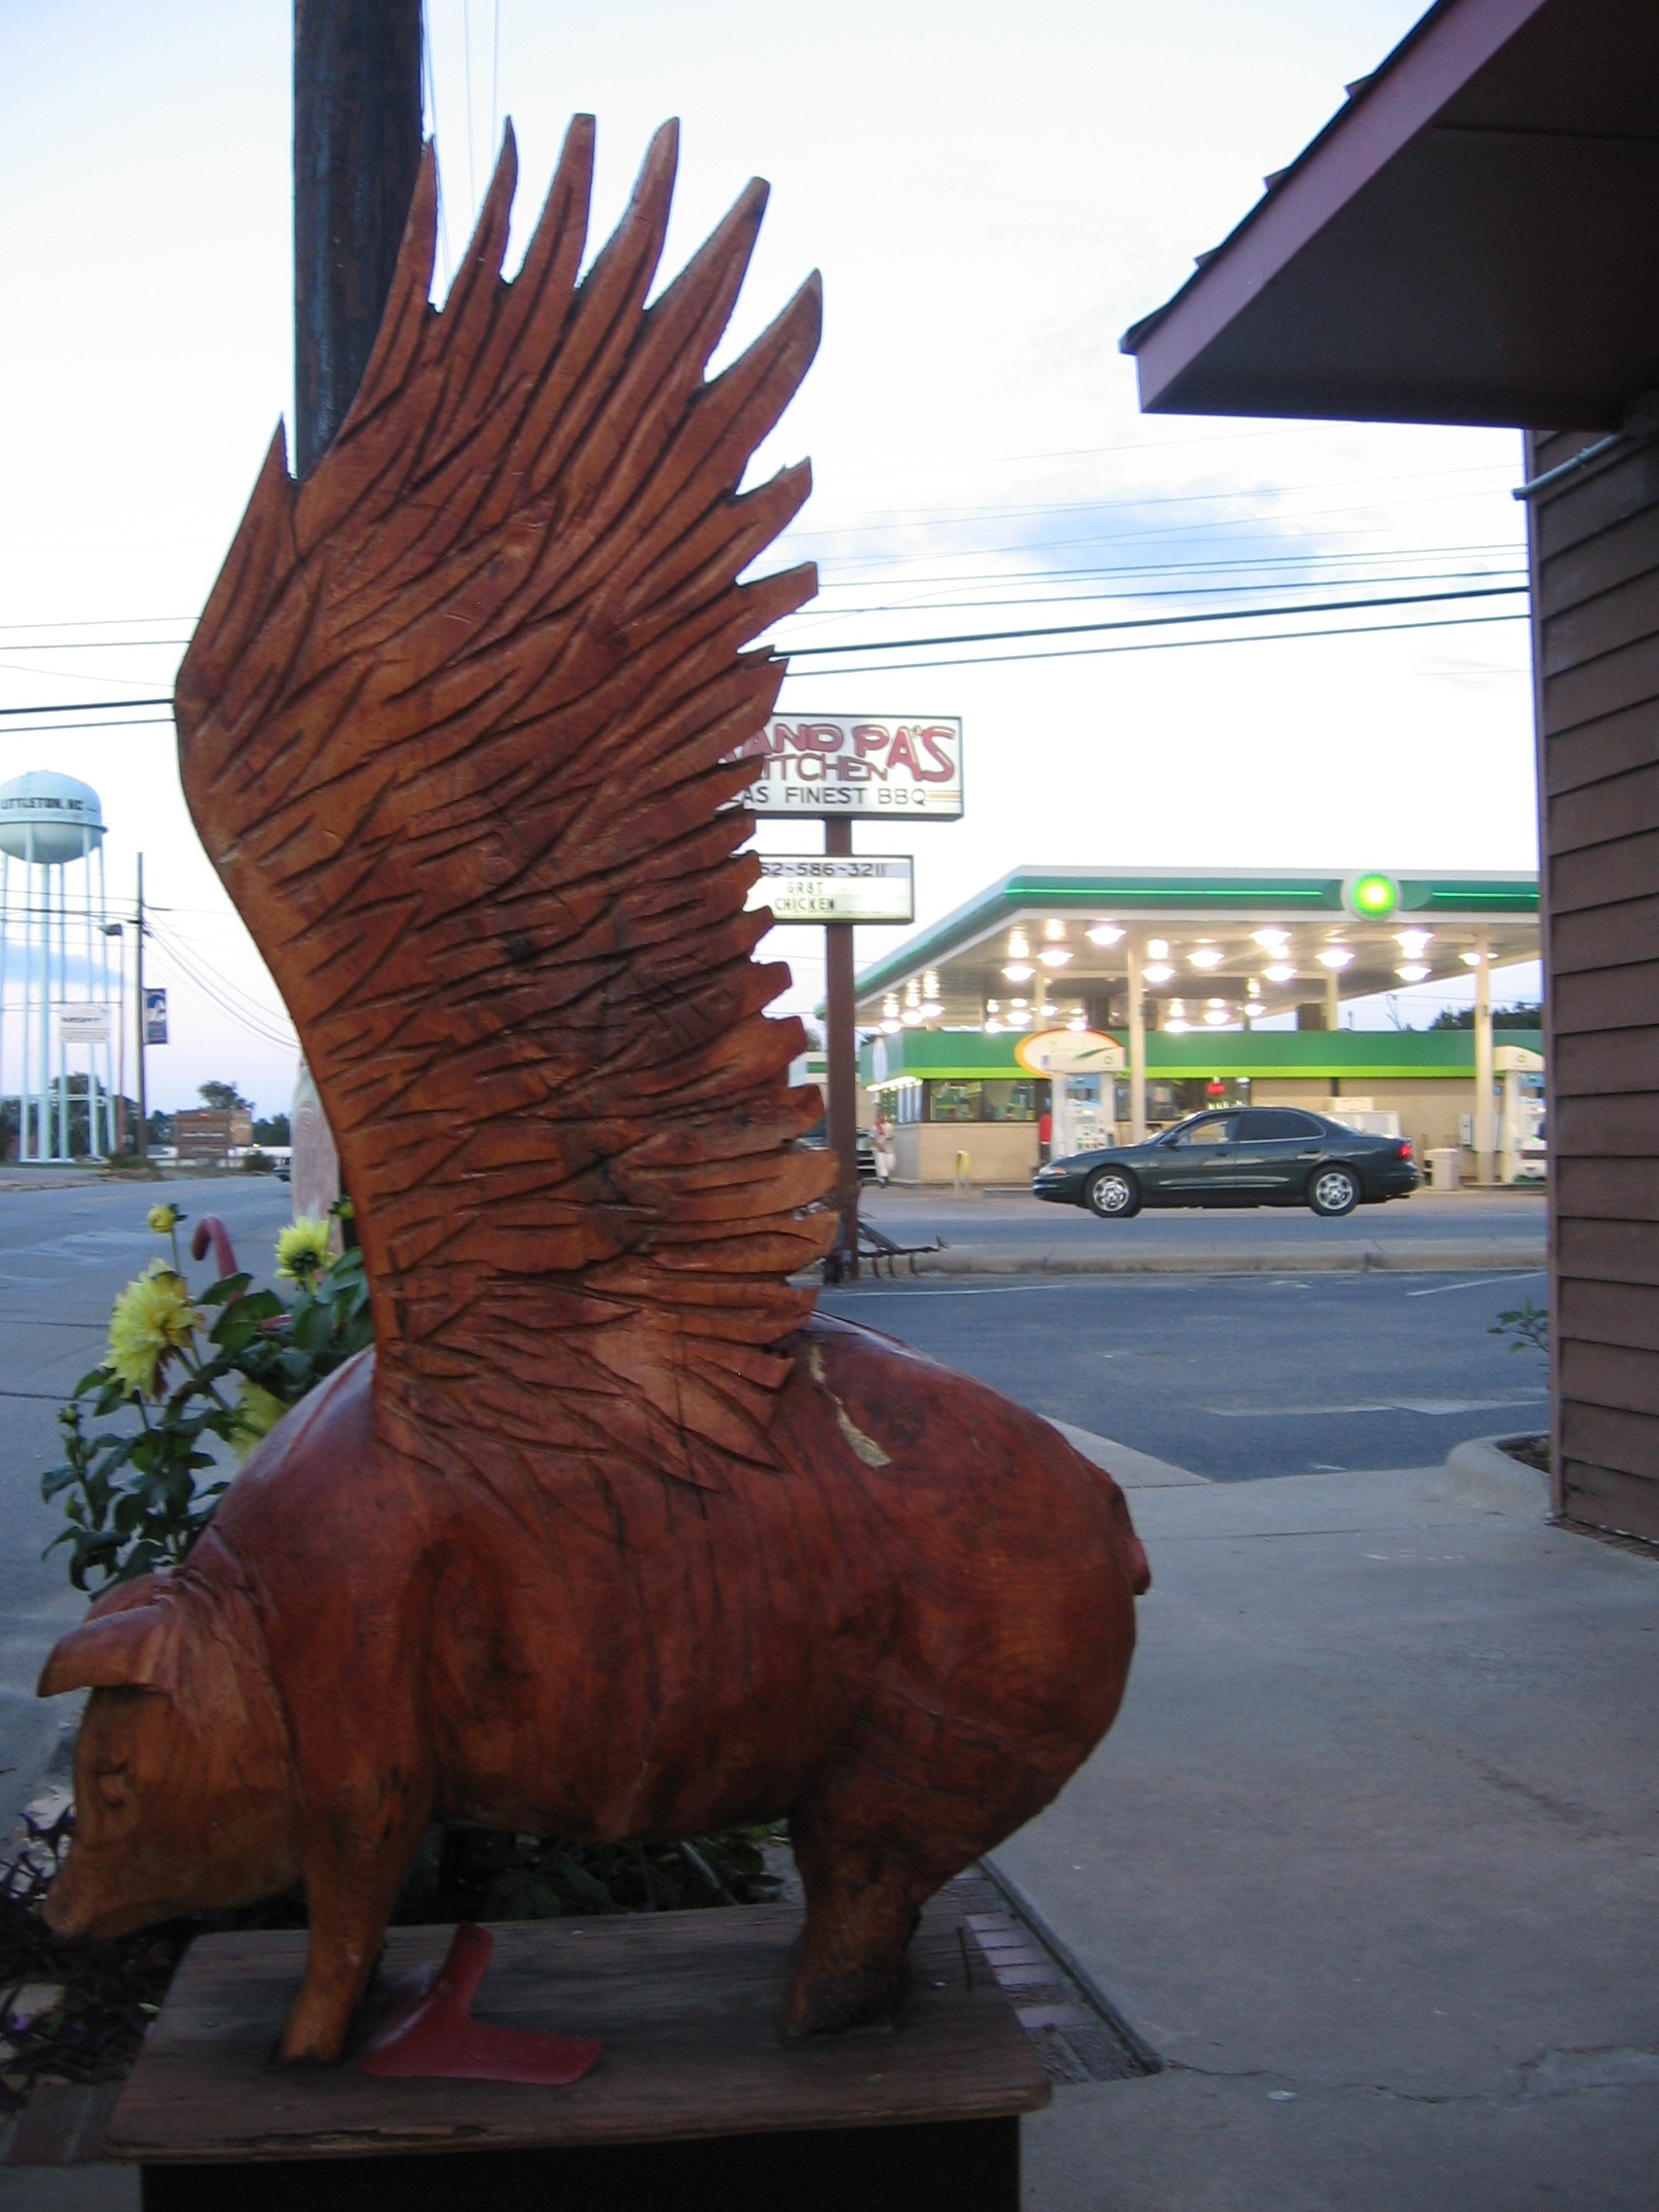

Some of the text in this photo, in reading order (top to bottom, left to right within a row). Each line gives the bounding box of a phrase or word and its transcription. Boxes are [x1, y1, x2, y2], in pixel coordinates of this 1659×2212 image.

[762, 753, 888, 781] ITCHEN
[743, 787, 926, 806] AS FINEST BBQ
[760, 863, 886, 876] 52-586-3211
[787, 881, 824, 894] GR8T
[775, 898, 835, 911] CHICKEN
